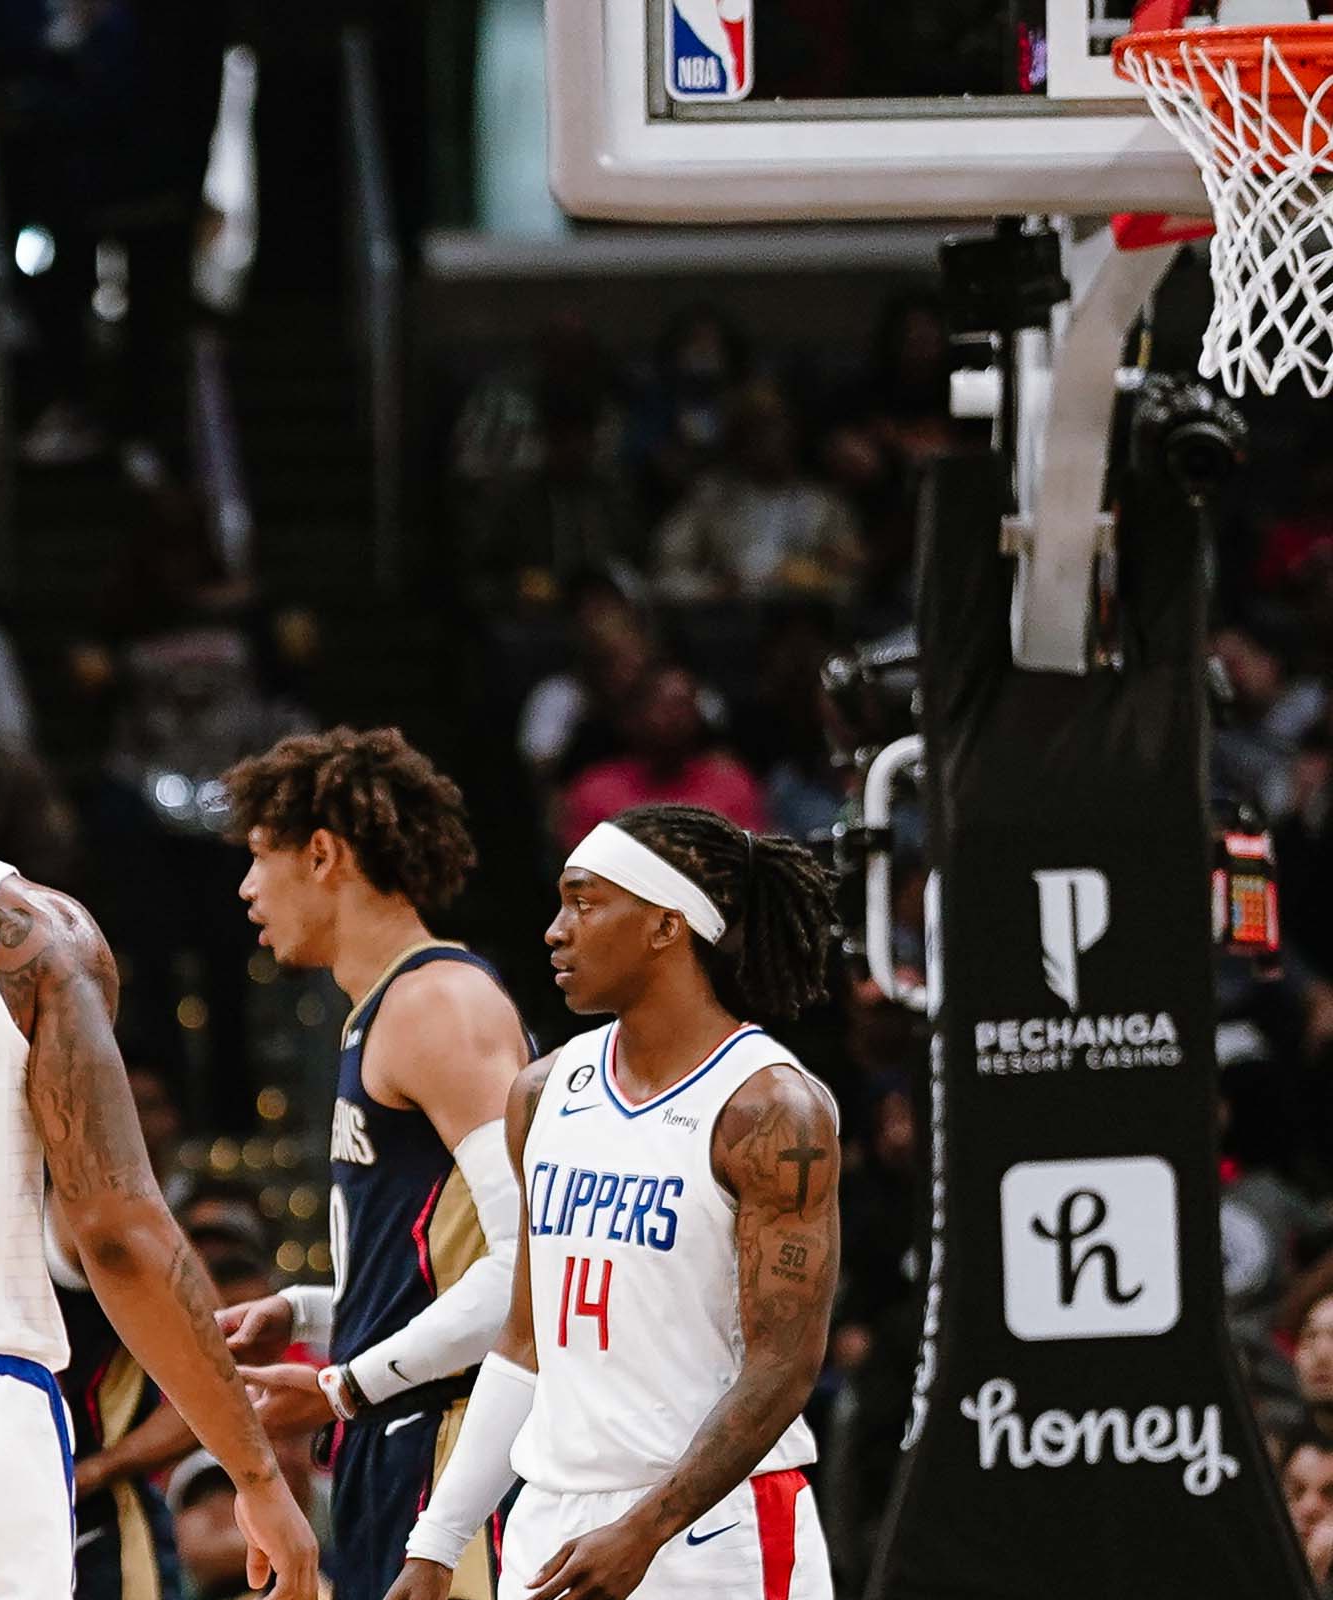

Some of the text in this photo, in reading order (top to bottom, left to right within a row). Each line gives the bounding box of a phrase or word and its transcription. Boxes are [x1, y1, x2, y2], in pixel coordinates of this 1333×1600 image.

[677, 56, 721, 90] NBA
[974, 1011, 1179, 1053] PECHANGA
[1084, 1043, 1184, 1071] CASINO
[529, 1161, 684, 1252] CLIPPERS
[1030, 1188, 1143, 1307] h
[557, 1256, 613, 1351] 14
[960, 1377, 1241, 1498] honey
